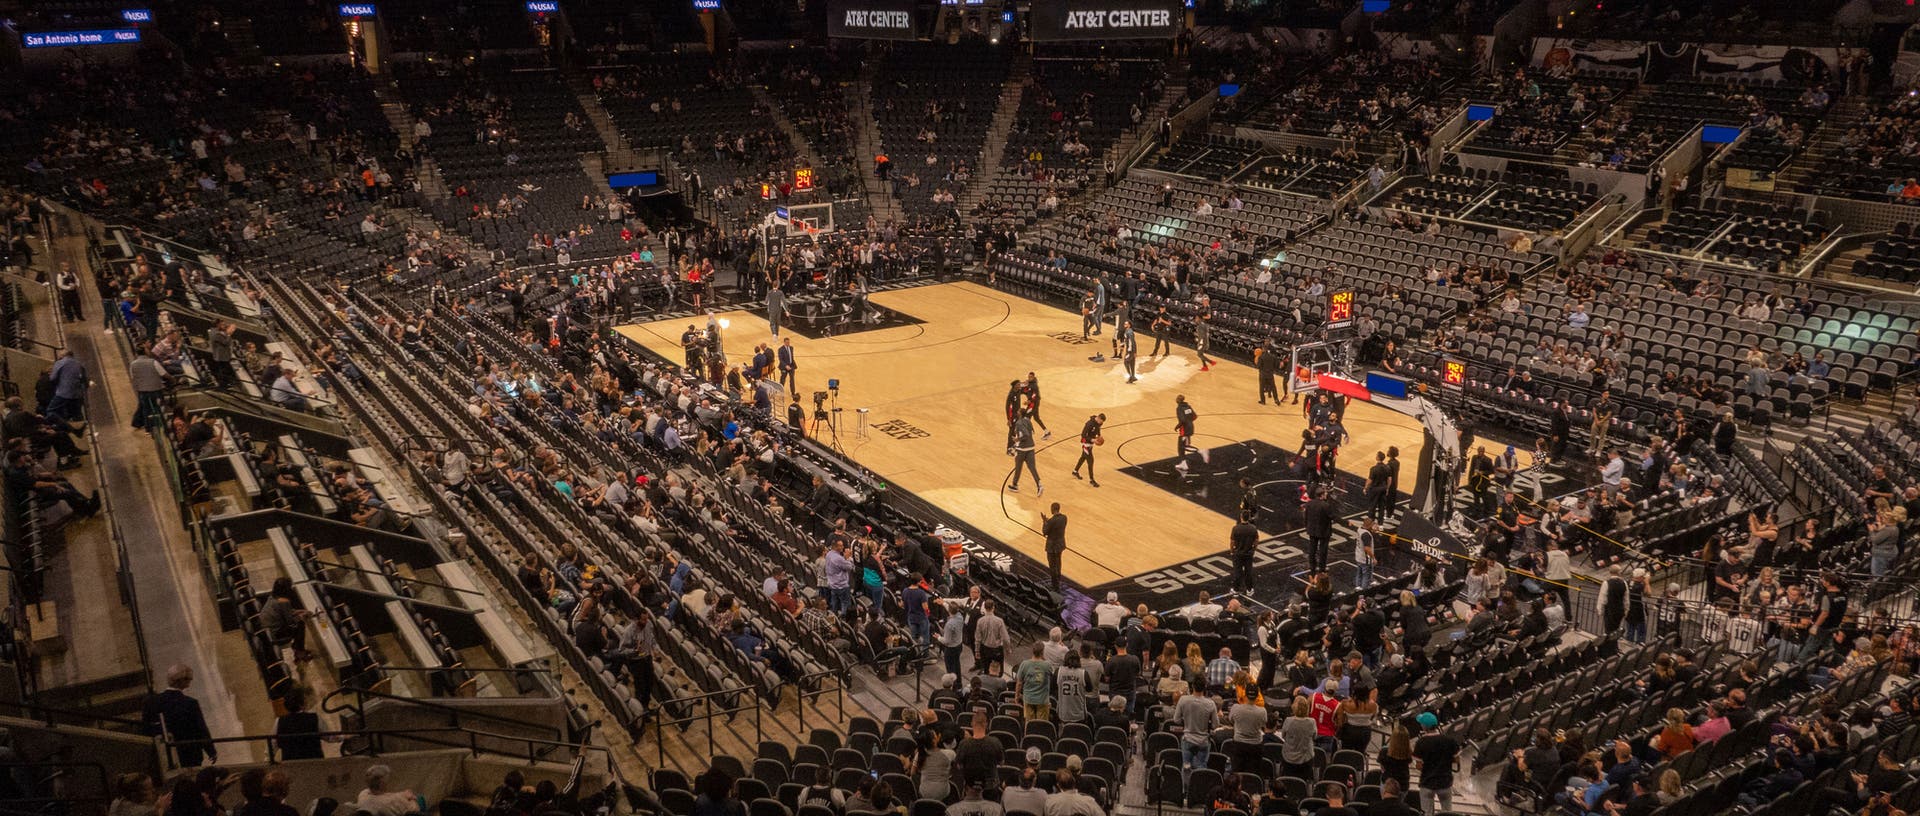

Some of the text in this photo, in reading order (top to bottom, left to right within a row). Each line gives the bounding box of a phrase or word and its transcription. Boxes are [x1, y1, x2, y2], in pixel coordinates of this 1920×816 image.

[845, 10, 909, 28] AT&T CENTER
[1065, 10, 1170, 28] AT&T CENTER
[27, 33, 102, 45] San Antonio home
[797, 176, 810, 188] 24
[1331, 303, 1349, 320] 24
[1447, 371, 1461, 382] 24
[1062, 683, 1079, 696] 21
